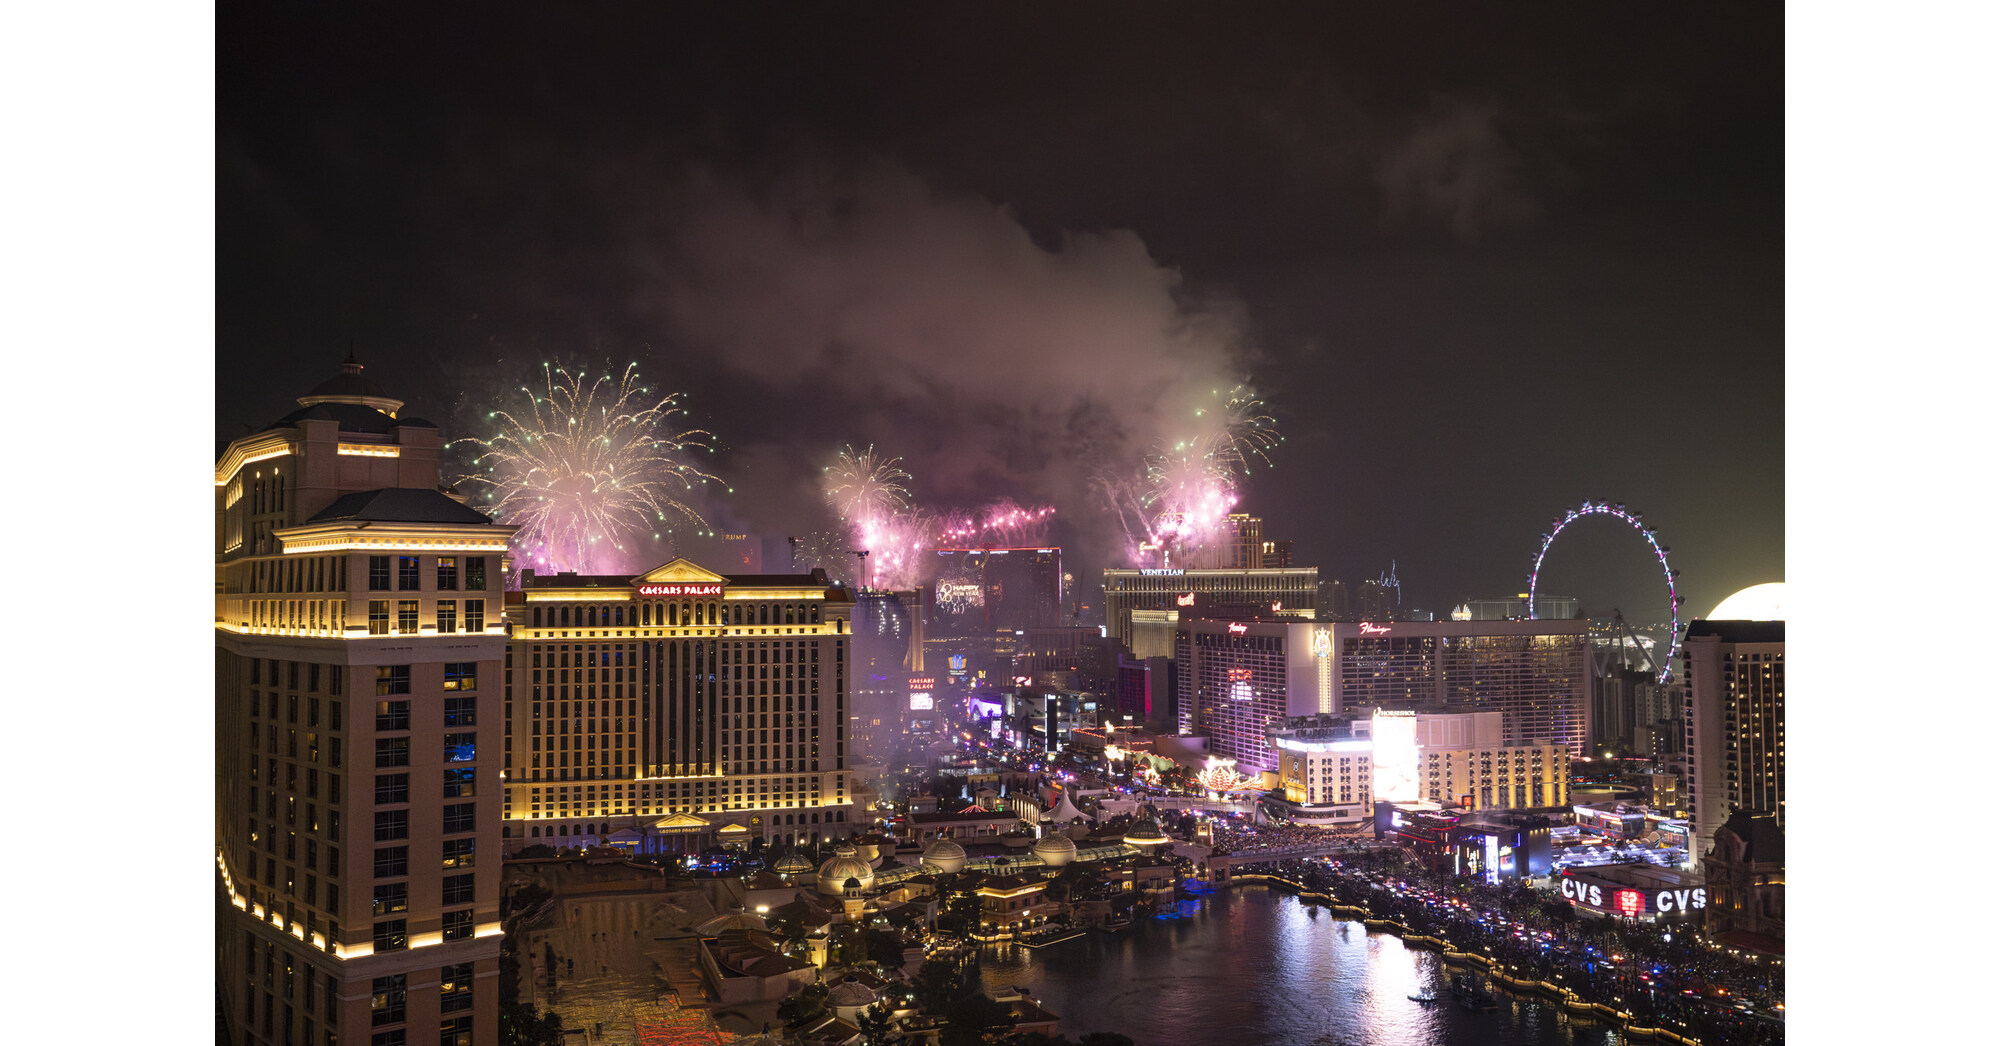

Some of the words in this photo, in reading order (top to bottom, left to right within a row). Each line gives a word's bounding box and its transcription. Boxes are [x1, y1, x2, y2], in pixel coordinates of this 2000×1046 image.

[639, 586, 682, 595] CAESARS
[684, 586, 721, 594] PALACE
[1561, 877, 1602, 906] CVS
[1656, 888, 1706, 912] CVS
